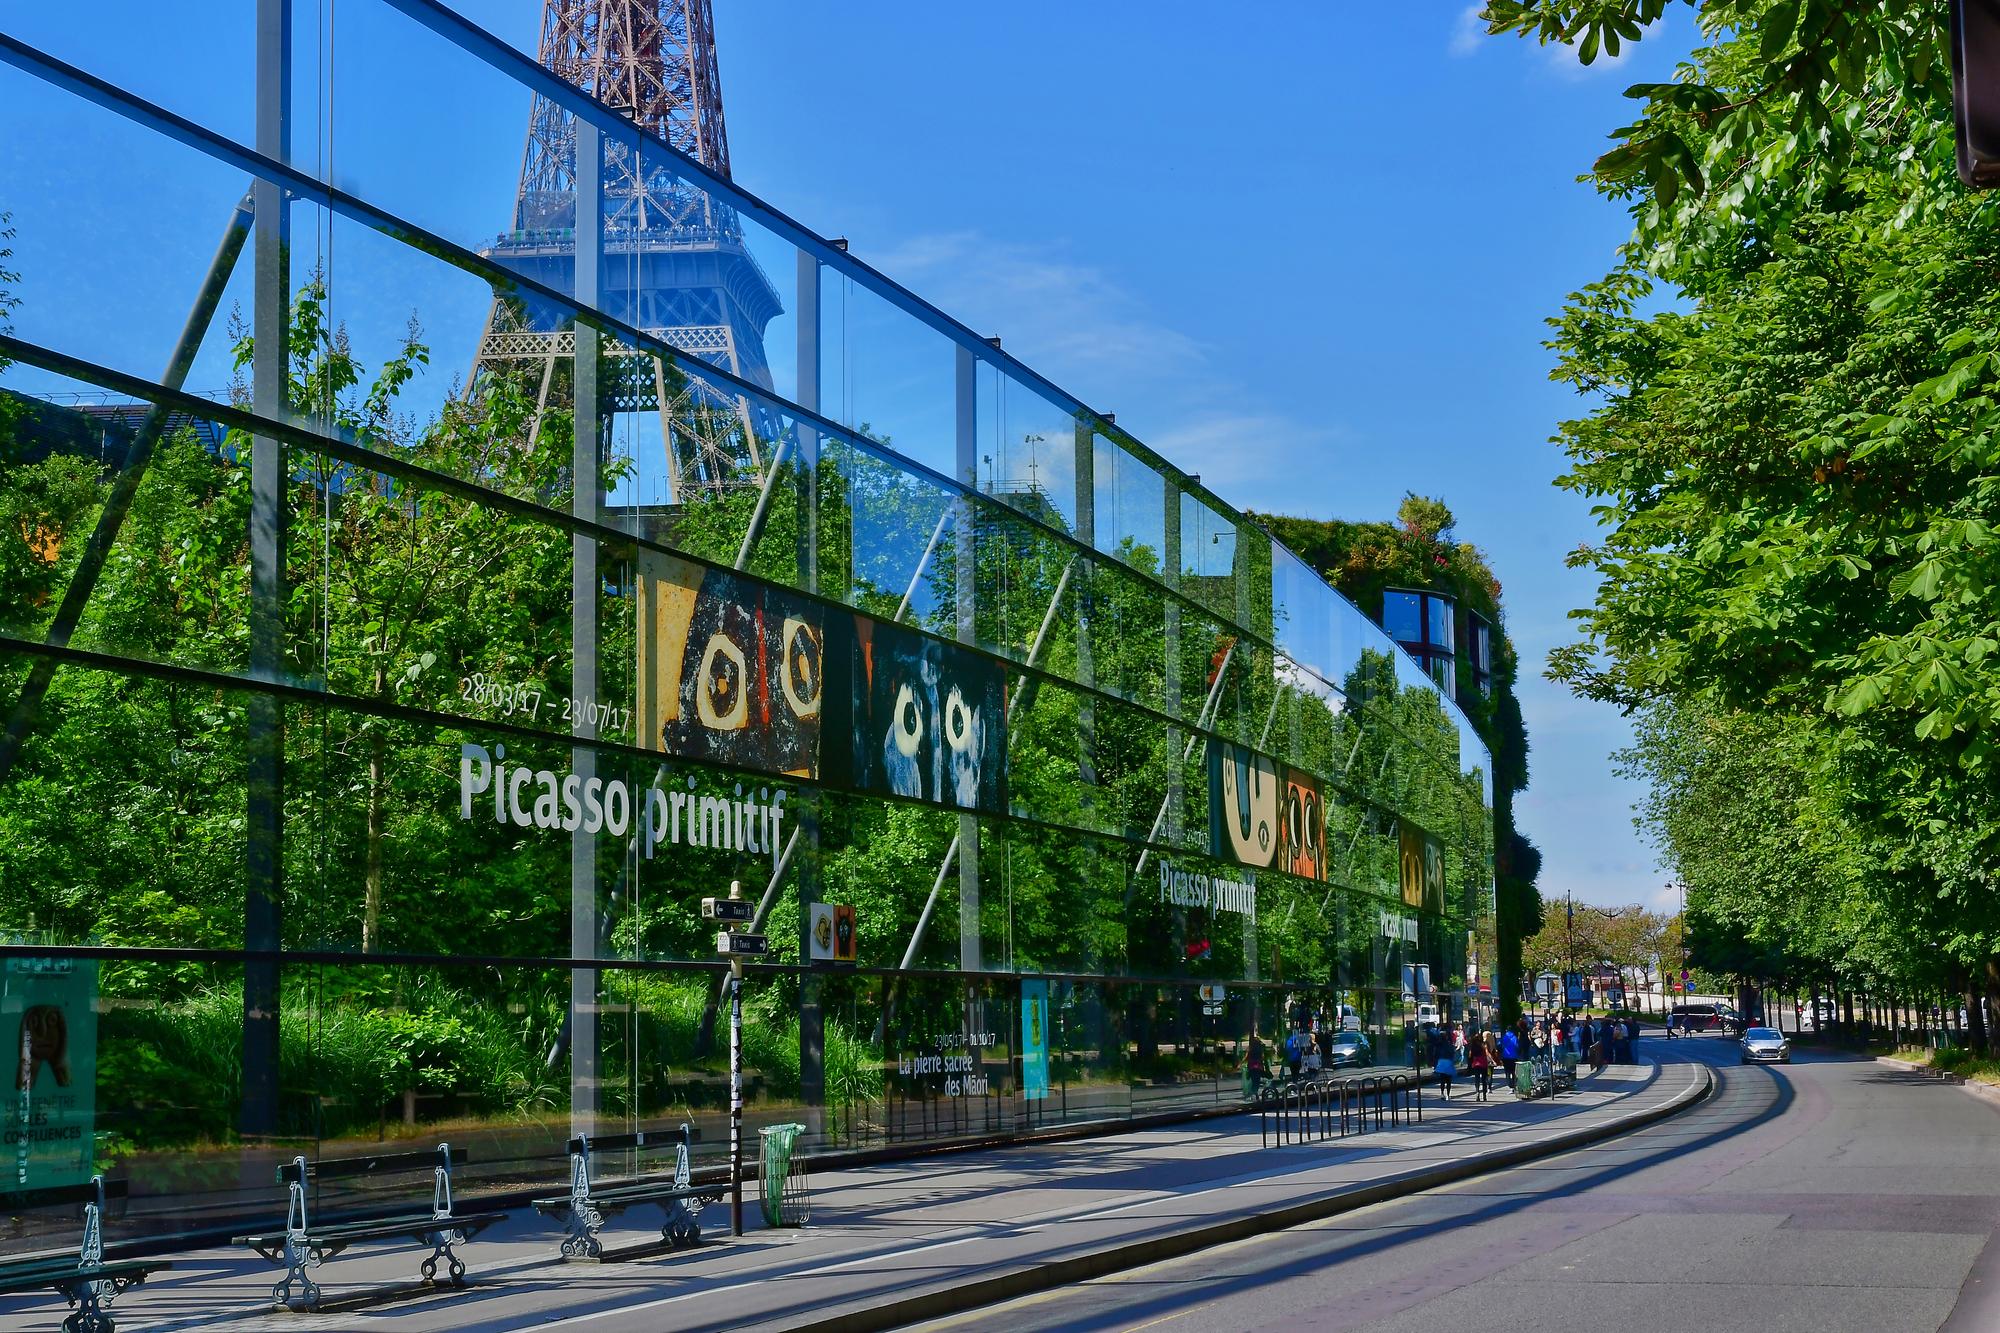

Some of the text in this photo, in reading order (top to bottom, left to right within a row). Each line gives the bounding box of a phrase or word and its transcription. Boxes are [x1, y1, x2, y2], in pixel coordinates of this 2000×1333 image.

[463, 673, 541, 721] 28/03/17
[562, 695, 630, 737] 23/07/17
[461, 743, 787, 872] Picasso primitif
[1160, 859, 1209, 908] Picasso
[898, 1050, 973, 1079] La pierre sacrée
[944, 1075, 960, 1097] des
